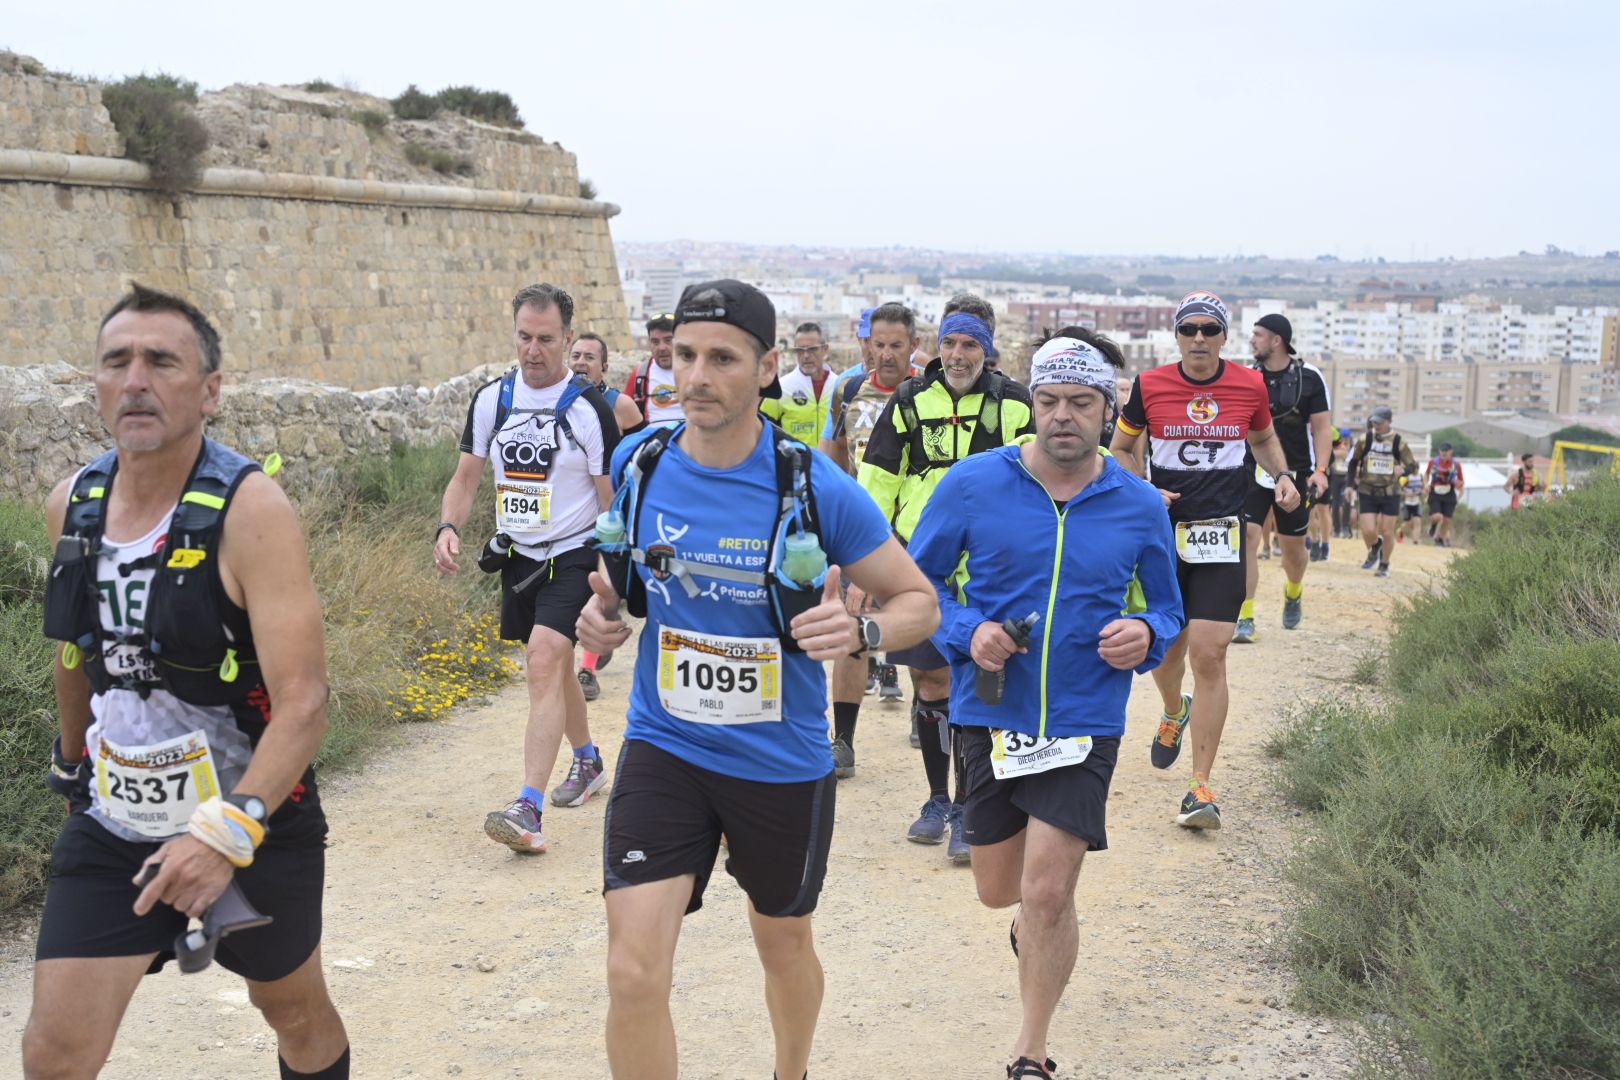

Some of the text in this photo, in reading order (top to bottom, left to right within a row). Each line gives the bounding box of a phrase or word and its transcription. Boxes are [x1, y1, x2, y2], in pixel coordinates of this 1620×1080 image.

[511, 432, 551, 443] ZERRICHE
[1164, 425, 1240, 437] CUATRO SANTOS
[501, 441, 551, 466] COC
[1178, 440, 1225, 467] CT
[503, 497, 539, 515] 1594
[718, 537, 768, 551] #RETO1
[1186, 530, 1229, 546] 4481
[694, 552, 733, 565] VUELTA
[735, 555, 744, 565] A
[725, 646, 757, 658] 2023
[677, 659, 758, 694] 1095
[699, 698, 724, 710] PABLO
[147, 749, 184, 768] 2023
[1017, 752, 1036, 766] DIEGO
[1036, 747, 1063, 761] HEREDIA
[108, 771, 189, 805] 2537
